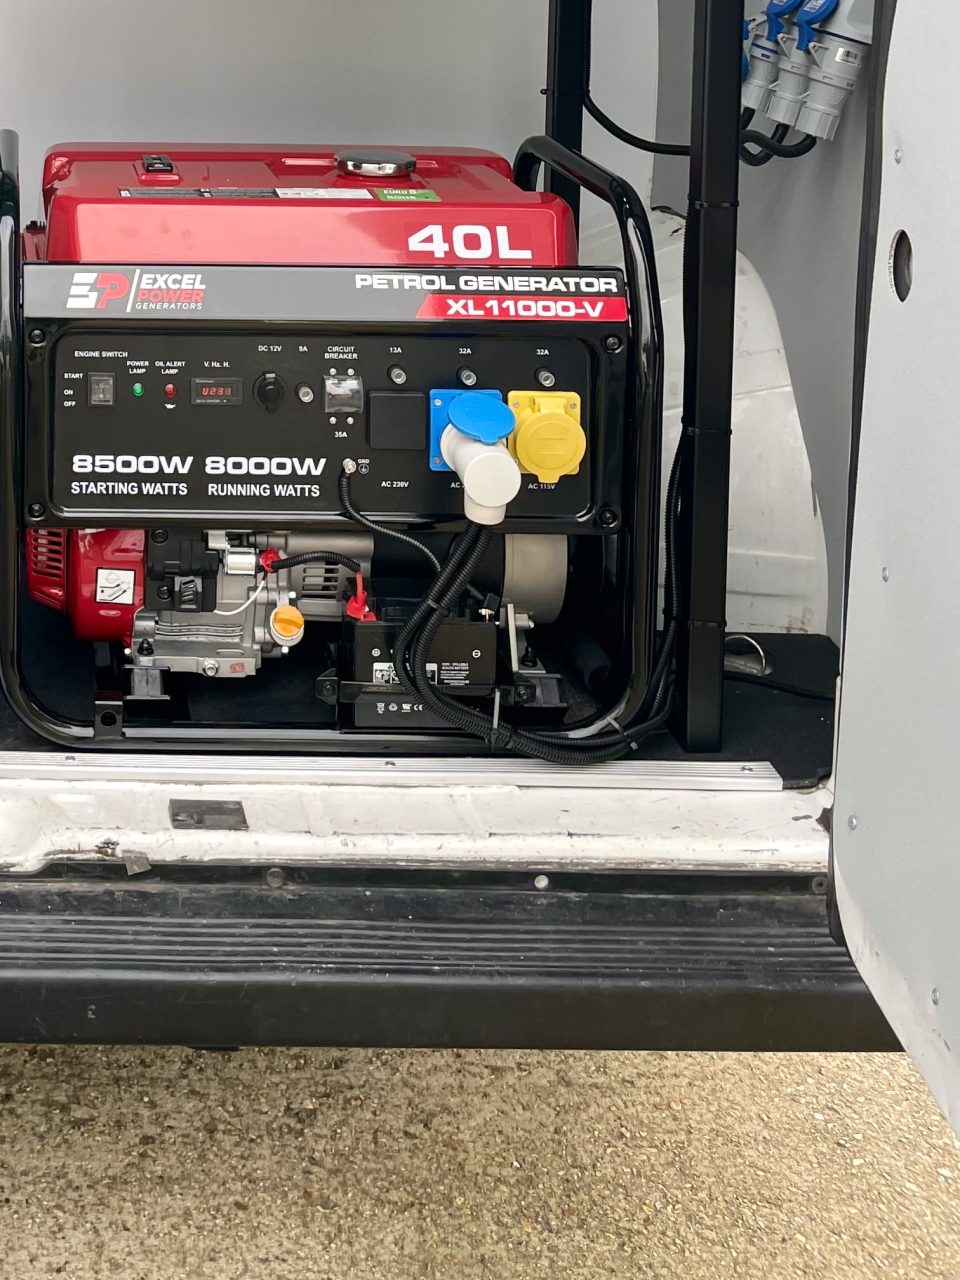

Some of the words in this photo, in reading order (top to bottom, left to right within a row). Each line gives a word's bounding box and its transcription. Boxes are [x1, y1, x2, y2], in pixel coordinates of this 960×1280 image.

[407, 224, 533, 260] 40L
[140, 273, 206, 289] EXCEL
[355, 274, 456, 291] PETROL
[460, 275, 618, 293] GENERATOR
[137, 288, 205, 303] POWER
[135, 302, 203, 310] GENERATORS
[446, 299, 604, 318] XL11000-V
[72, 454, 194, 475] 8500W
[205, 456, 327, 477] 8000W
[71, 481, 138, 496] STARTING
[141, 482, 188, 496] WATTS
[208, 483, 271, 497] RUNNING
[273, 484, 320, 498] WATTS
